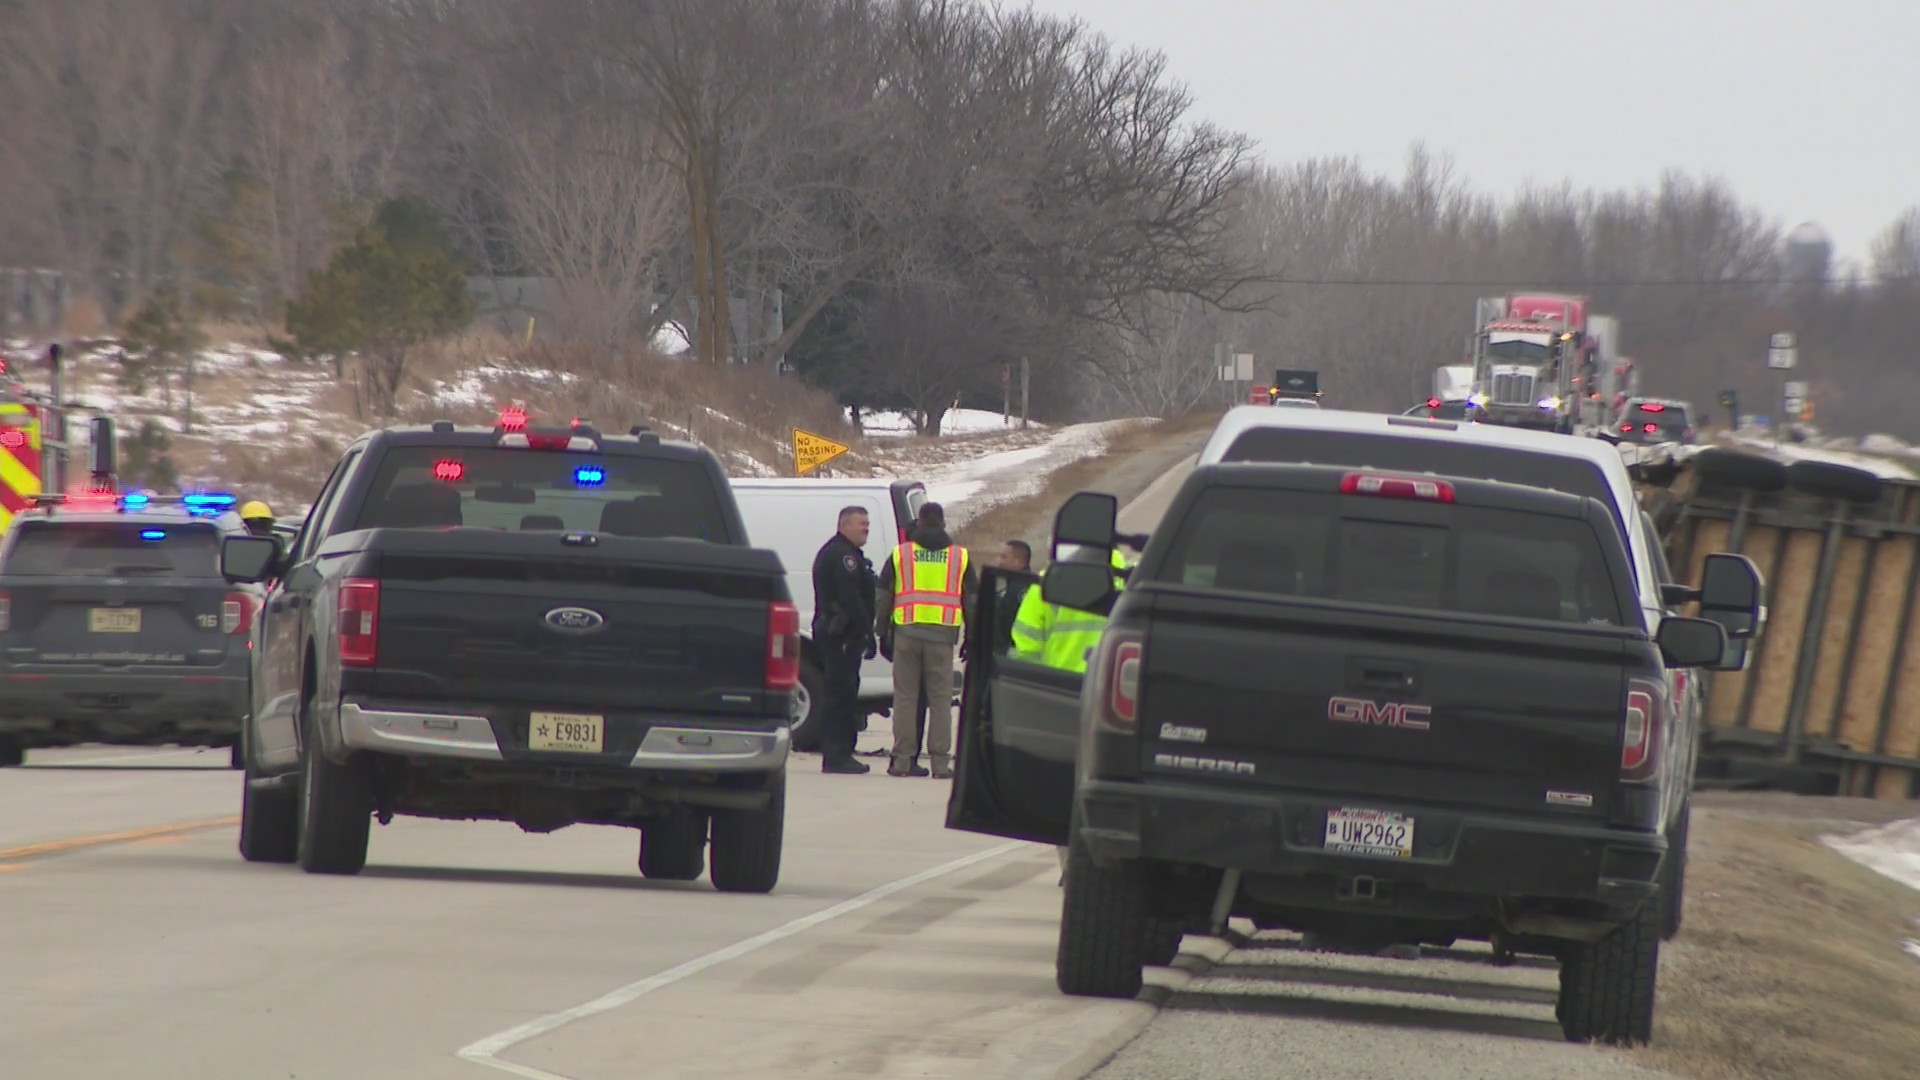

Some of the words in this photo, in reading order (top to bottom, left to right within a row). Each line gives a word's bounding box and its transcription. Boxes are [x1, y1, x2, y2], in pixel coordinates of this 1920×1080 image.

[797, 437, 810, 446] NO
[798, 445, 837, 456] PASSING
[799, 457, 819, 466] ZONE
[913, 549, 949, 564] SHERIFF
[196, 614, 218, 629] 16
[1328, 696, 1432, 731] GMC
[555, 722, 597, 743] E9831
[1155, 754, 1256, 774] SIERRA
[1342, 820, 1406, 848] UW2962
